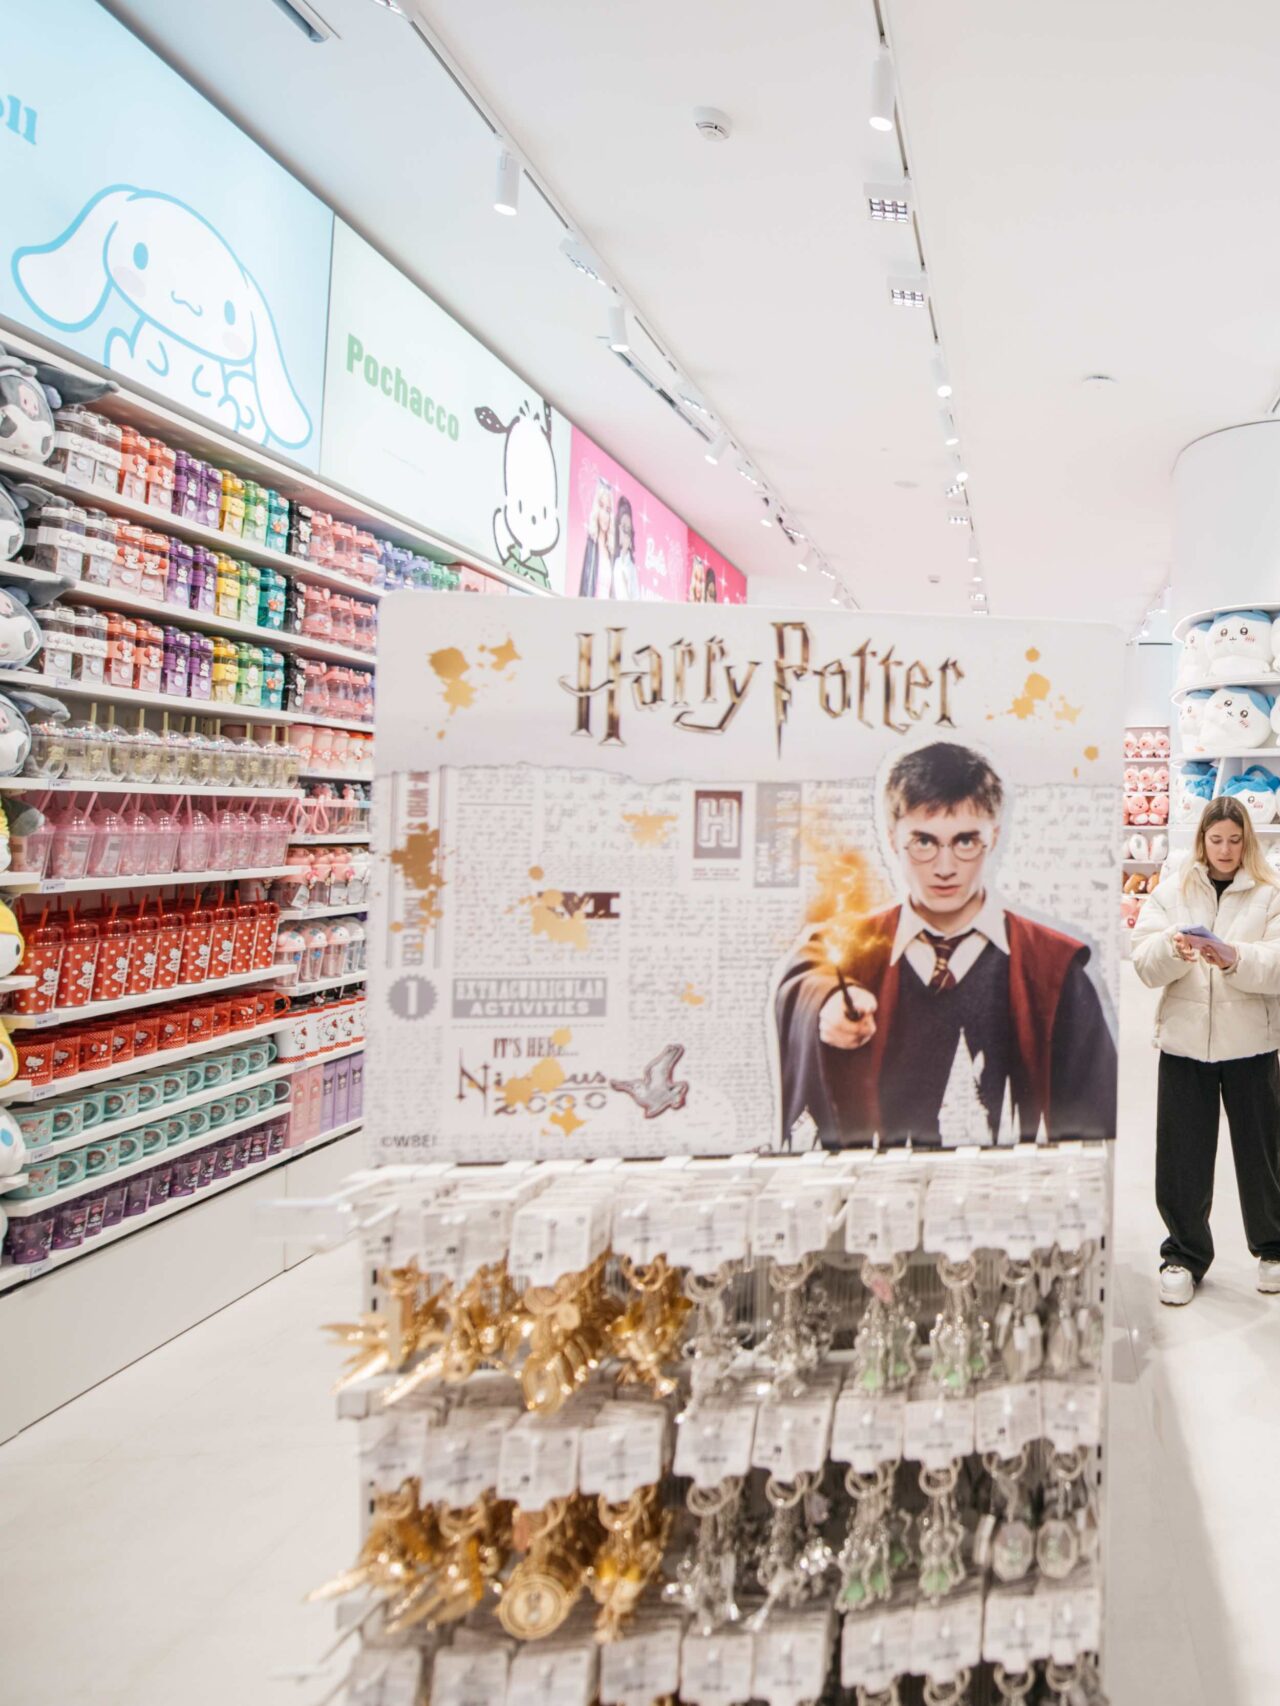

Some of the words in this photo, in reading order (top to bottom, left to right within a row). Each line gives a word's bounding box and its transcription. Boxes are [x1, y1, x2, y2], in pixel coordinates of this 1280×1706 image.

[346, 332, 460, 442] Pochacco
[558, 627, 762, 747] Harry
[770, 621, 965, 760] Potter
[454, 978, 605, 1000] EXTRACURRICULAR
[469, 1001, 591, 1017] ACTIVITIES
[493, 1037, 522, 1058] IT'S
[456, 1047, 607, 1118] Nius
